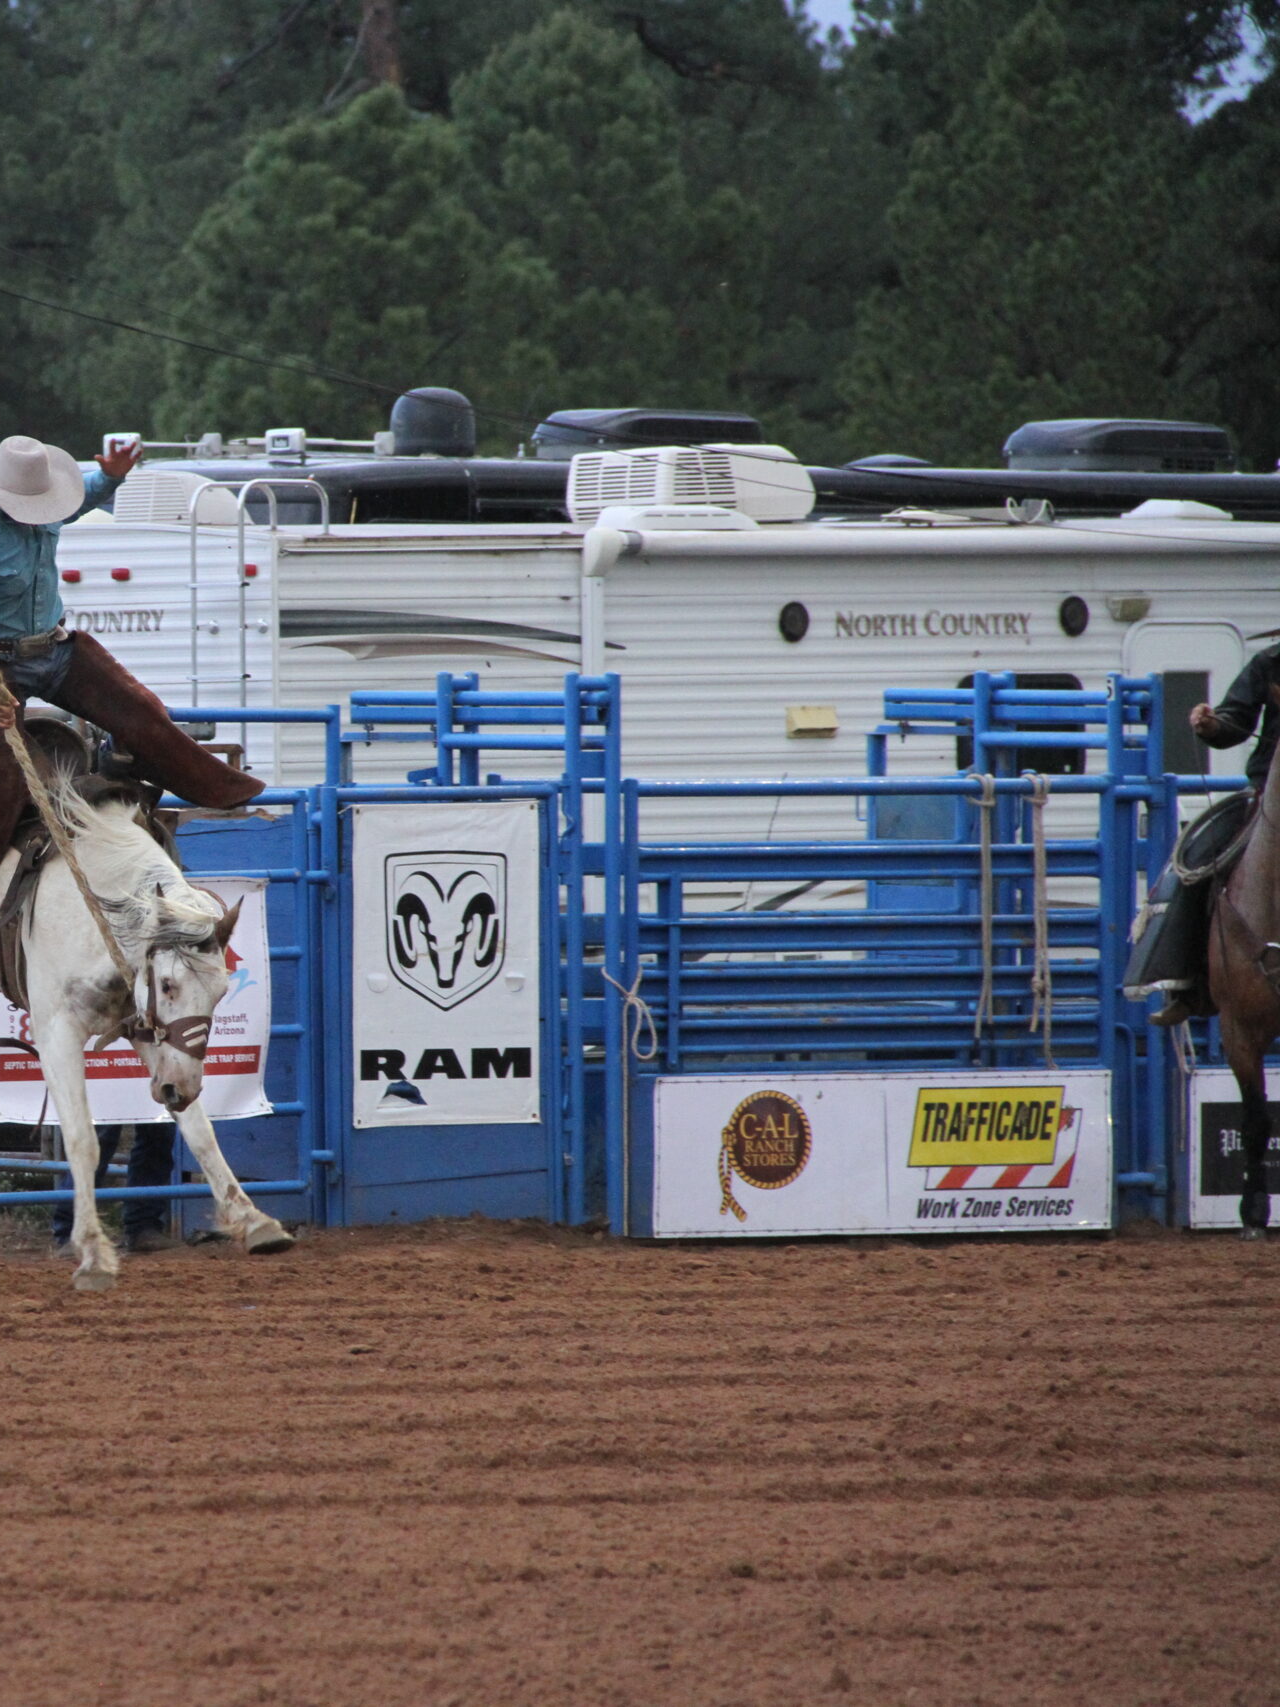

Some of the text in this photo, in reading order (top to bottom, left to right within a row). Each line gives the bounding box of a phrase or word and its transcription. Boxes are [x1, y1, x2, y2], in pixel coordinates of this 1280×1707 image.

[63, 609, 164, 633] COUNTRY
[214, 1013, 249, 1024] lagstaff,
[214, 1025, 246, 1035] Arizona
[4, 1061, 26, 1070] SEPTIC
[27, 1060, 42, 1069] TAN
[235, 1053, 256, 1062] SERVICE
[360, 1047, 531, 1080] RAM
[740, 1113, 799, 1140] C-A-L
[921, 1101, 1056, 1142] TRAFFICADE
[745, 1140, 794, 1153] RANCH
[743, 1153, 796, 1166] STORES
[916, 1196, 1074, 1219] Work Zone Services
